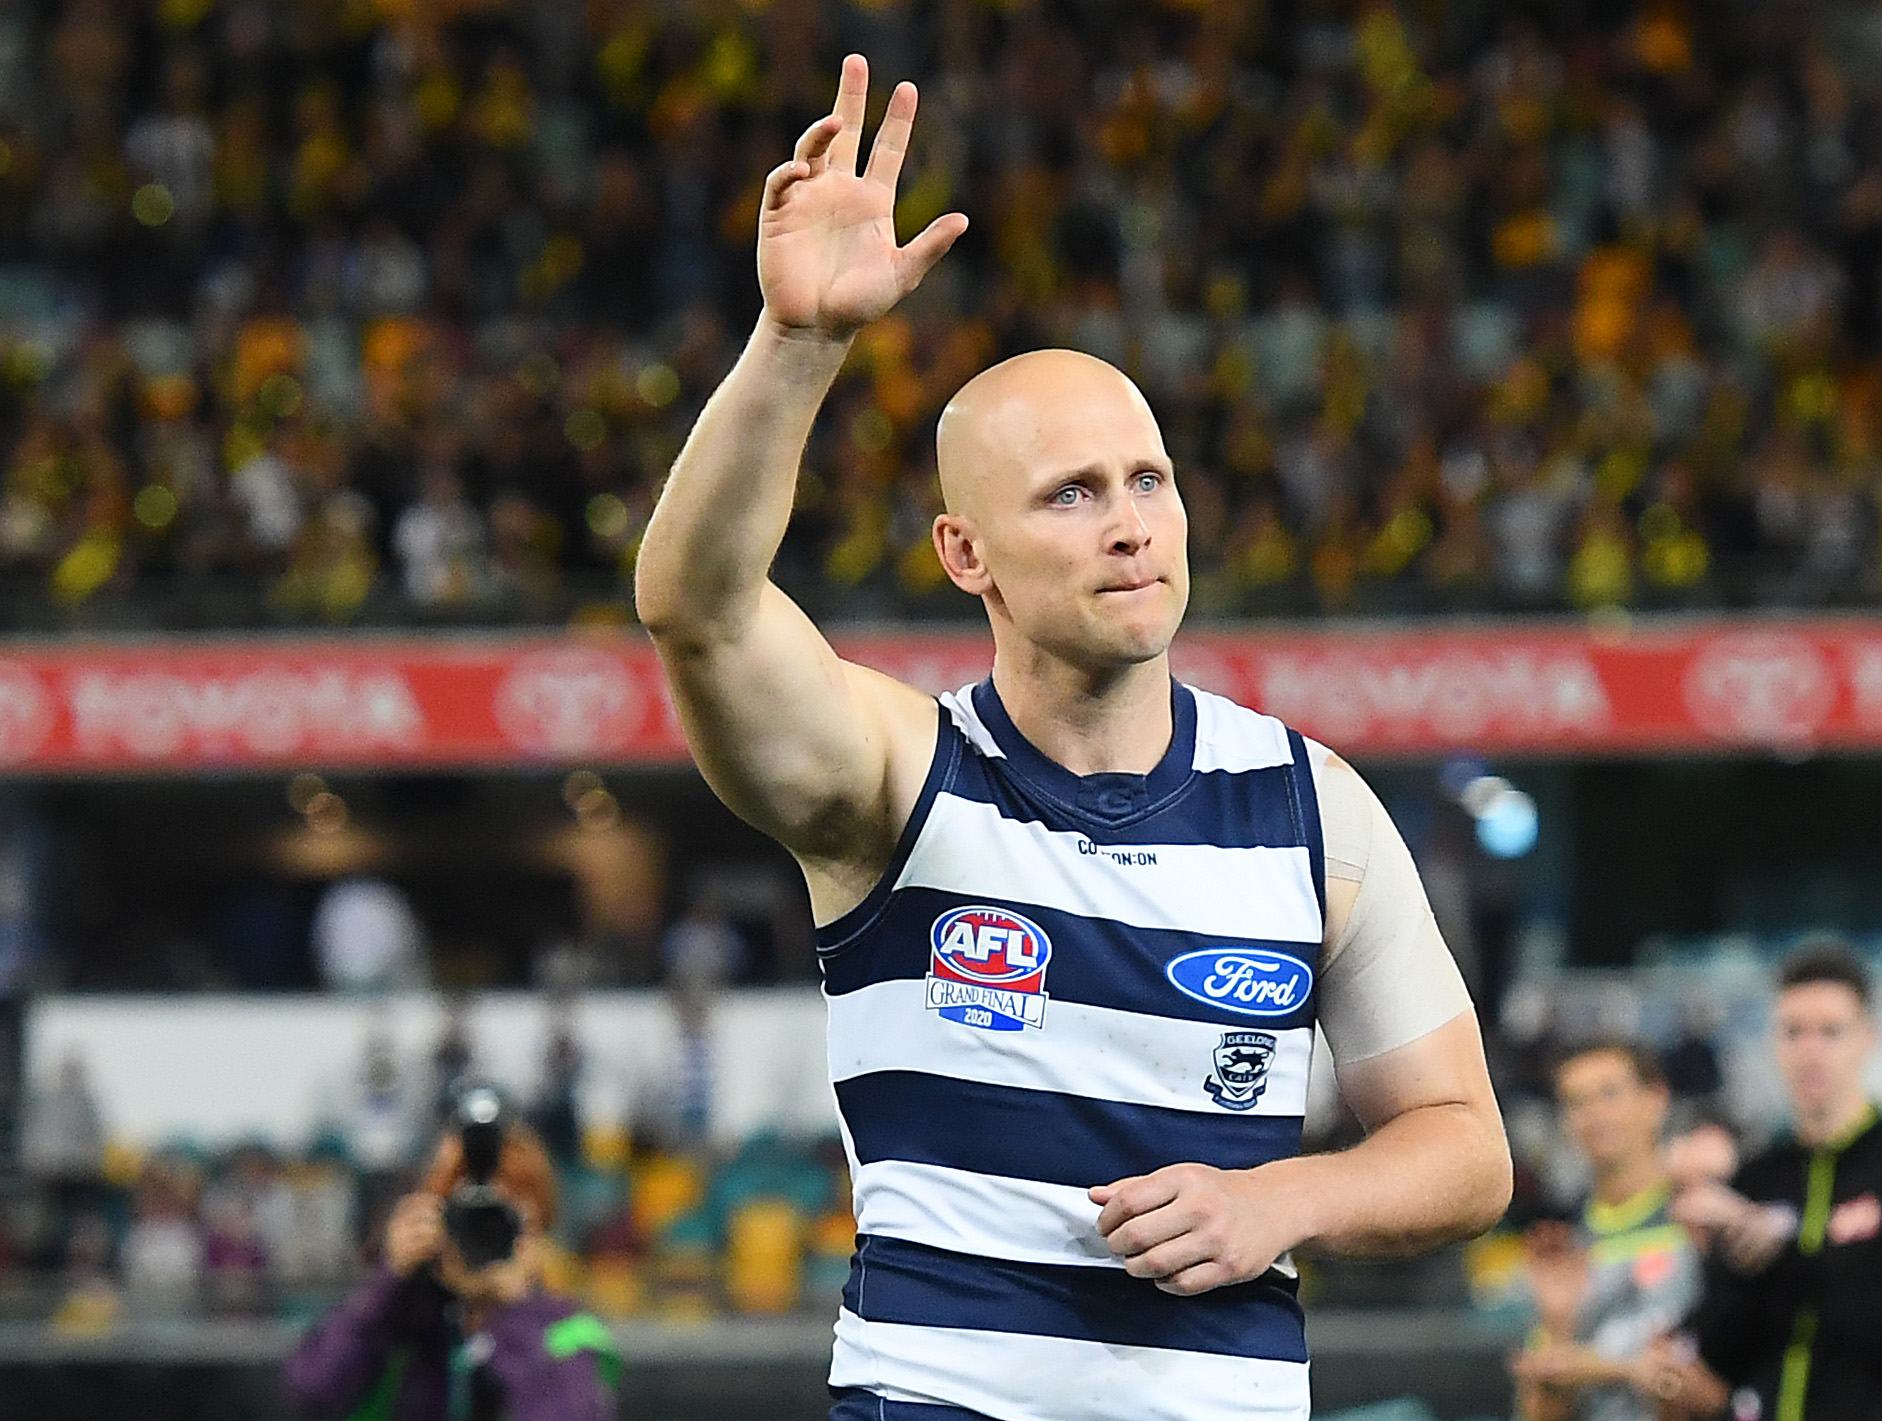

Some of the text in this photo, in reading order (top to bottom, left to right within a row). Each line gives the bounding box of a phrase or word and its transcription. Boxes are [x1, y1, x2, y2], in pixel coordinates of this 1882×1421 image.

[940, 921, 1038, 968] AFL
[930, 980, 1040, 1023] GRAND FINAL
[1203, 956, 1299, 1006] Ford
[964, 1007, 993, 1027] 2020
